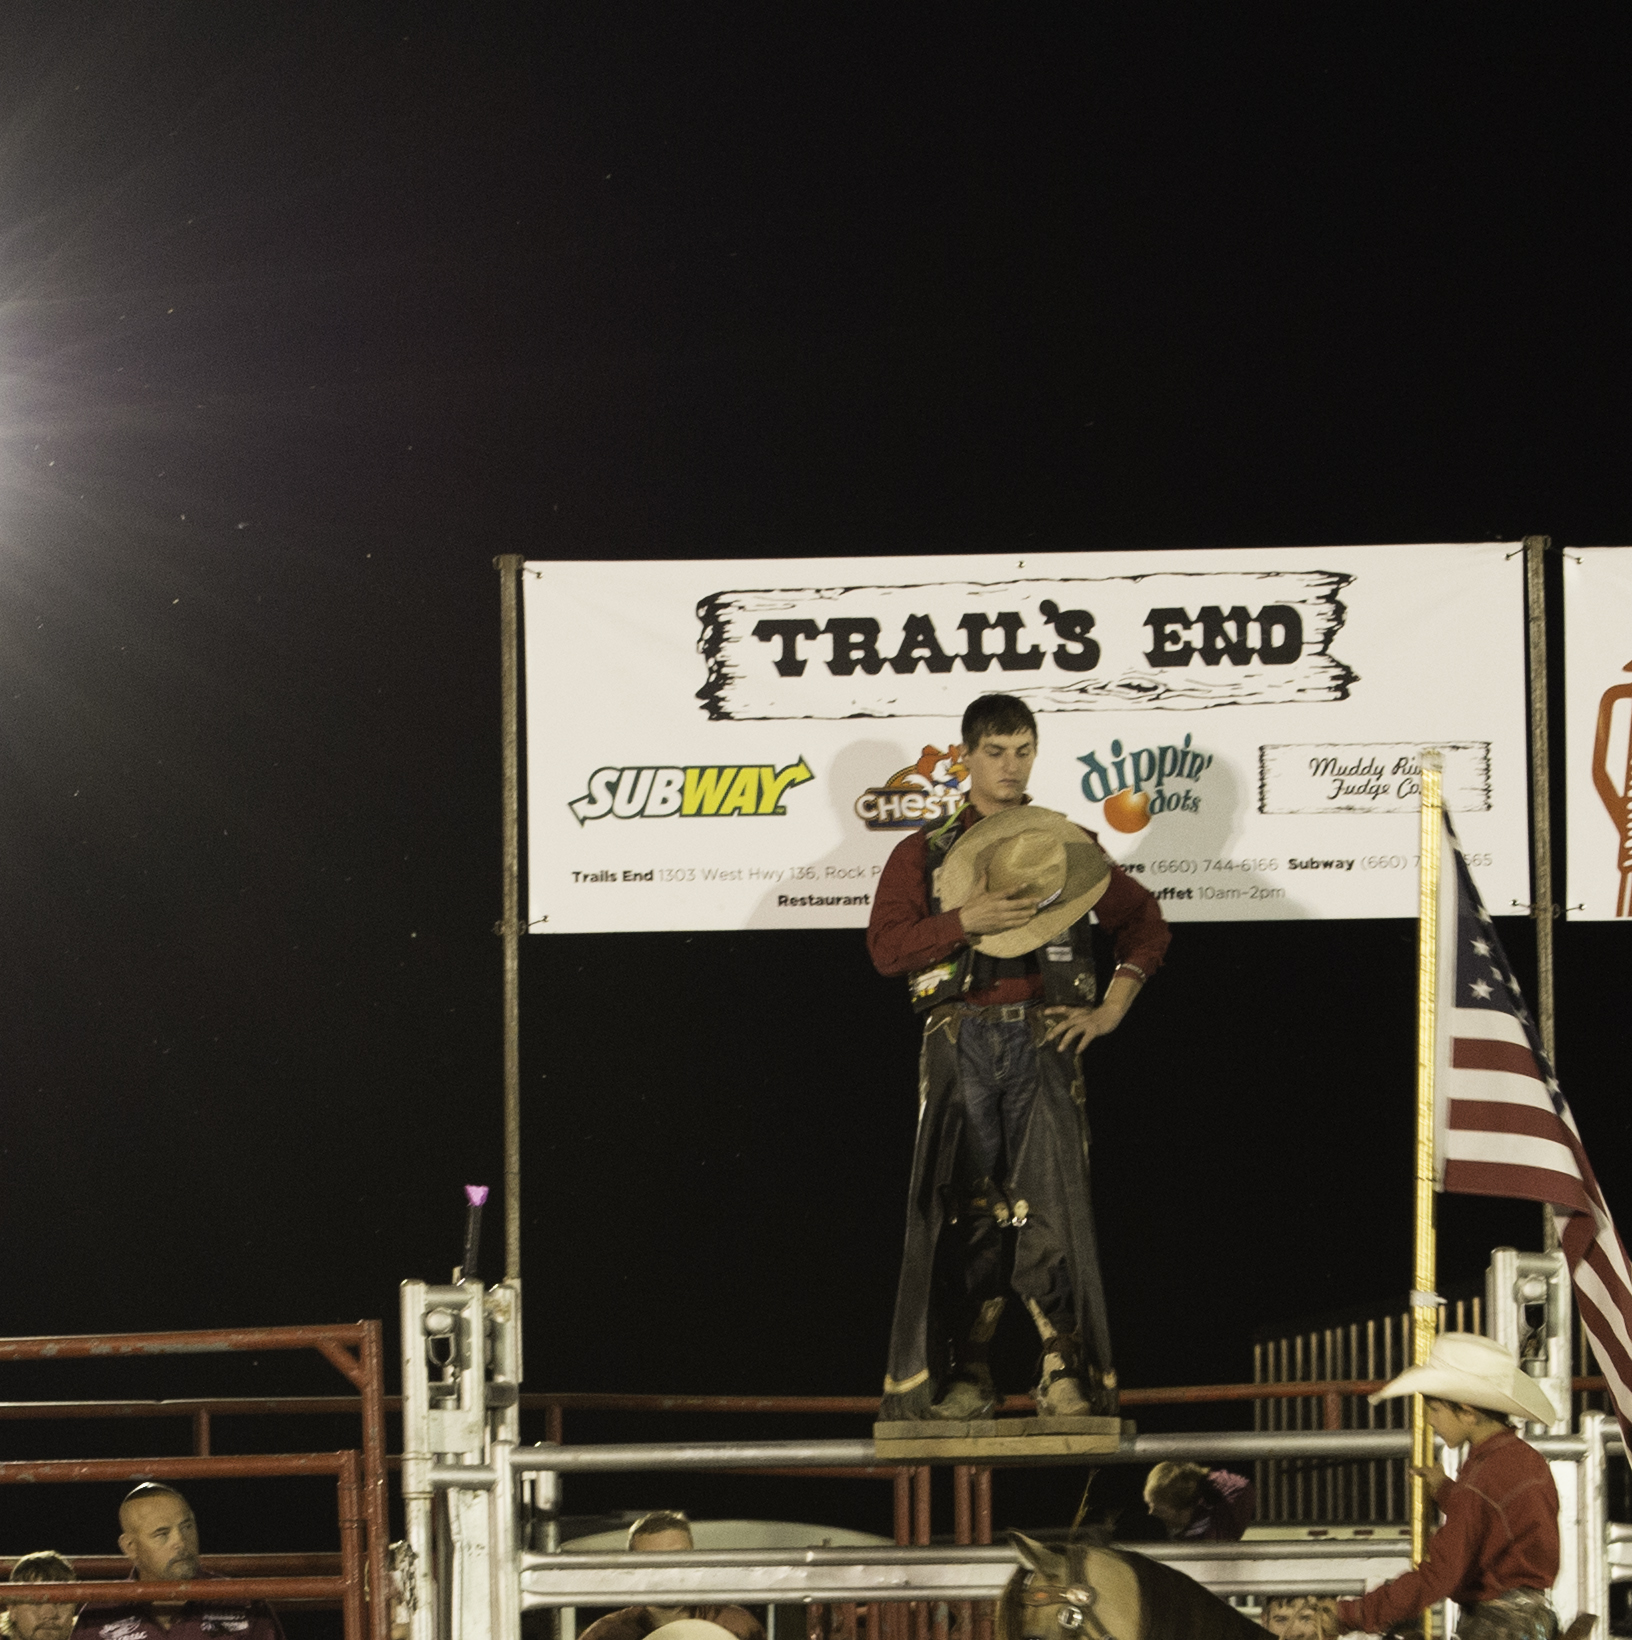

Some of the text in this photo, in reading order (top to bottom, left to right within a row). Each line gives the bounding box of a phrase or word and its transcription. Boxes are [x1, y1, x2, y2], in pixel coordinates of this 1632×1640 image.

[751, 599, 1303, 678] TRAIL'S END
[1309, 756, 1386, 780] Muddy
[568, 754, 815, 827] SUBWAY
[1149, 786, 1201, 816] dots
[1327, 778, 1390, 801] Fudge
[571, 870, 618, 884] Trails
[622, 869, 654, 883] End
[658, 867, 697, 883] 1303
[702, 867, 745, 882] West
[749, 867, 785, 884] Hwy
[825, 866, 867, 881] Rock
[1150, 857, 1198, 876] (660)
[1202, 857, 1280, 874] 744-6166
[1288, 856, 1355, 875] Subway
[1360, 854, 1408, 872] (660)
[777, 885, 1287, 907] Restaurant uffet 10am-2pm
